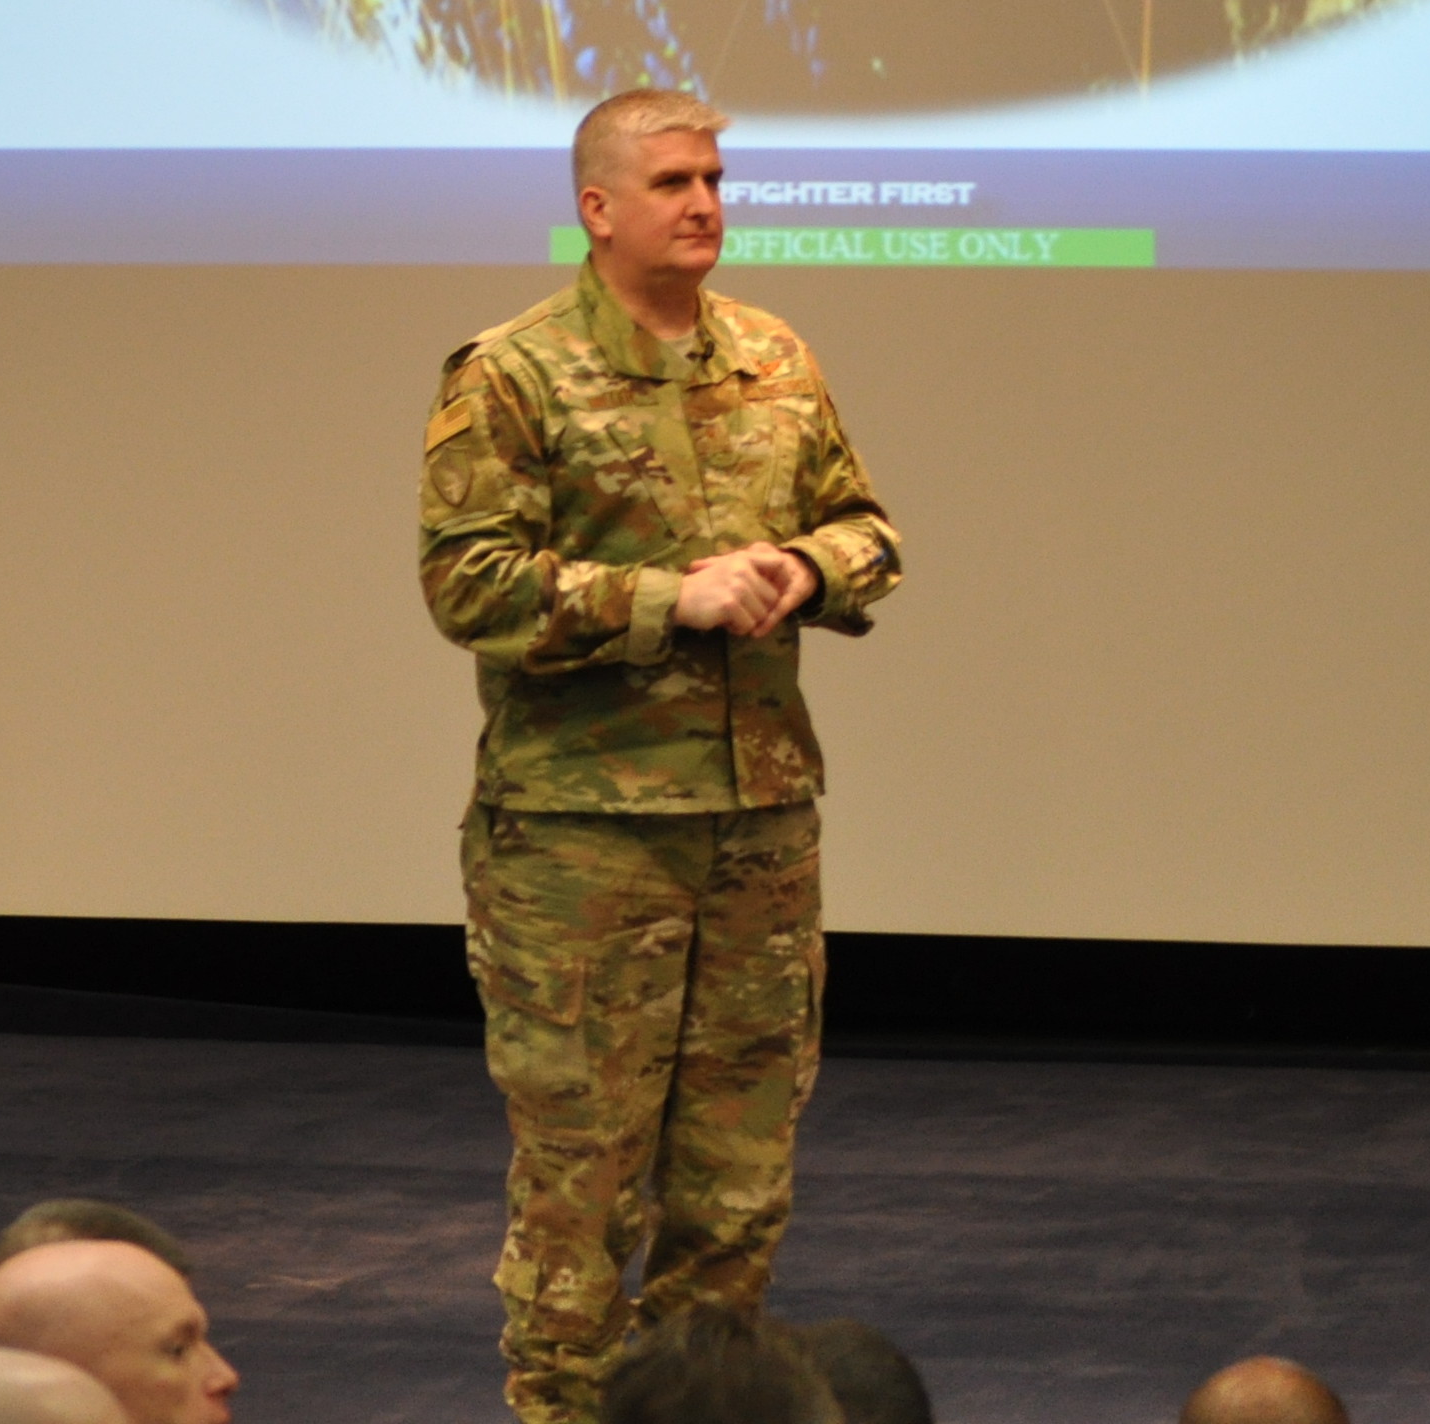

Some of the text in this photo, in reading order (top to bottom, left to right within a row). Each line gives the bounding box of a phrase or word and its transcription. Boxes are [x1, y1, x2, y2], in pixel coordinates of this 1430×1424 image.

[879, 181, 976, 205] FIRST
[723, 230, 1059, 261] OFFICIAL USE ONLY
